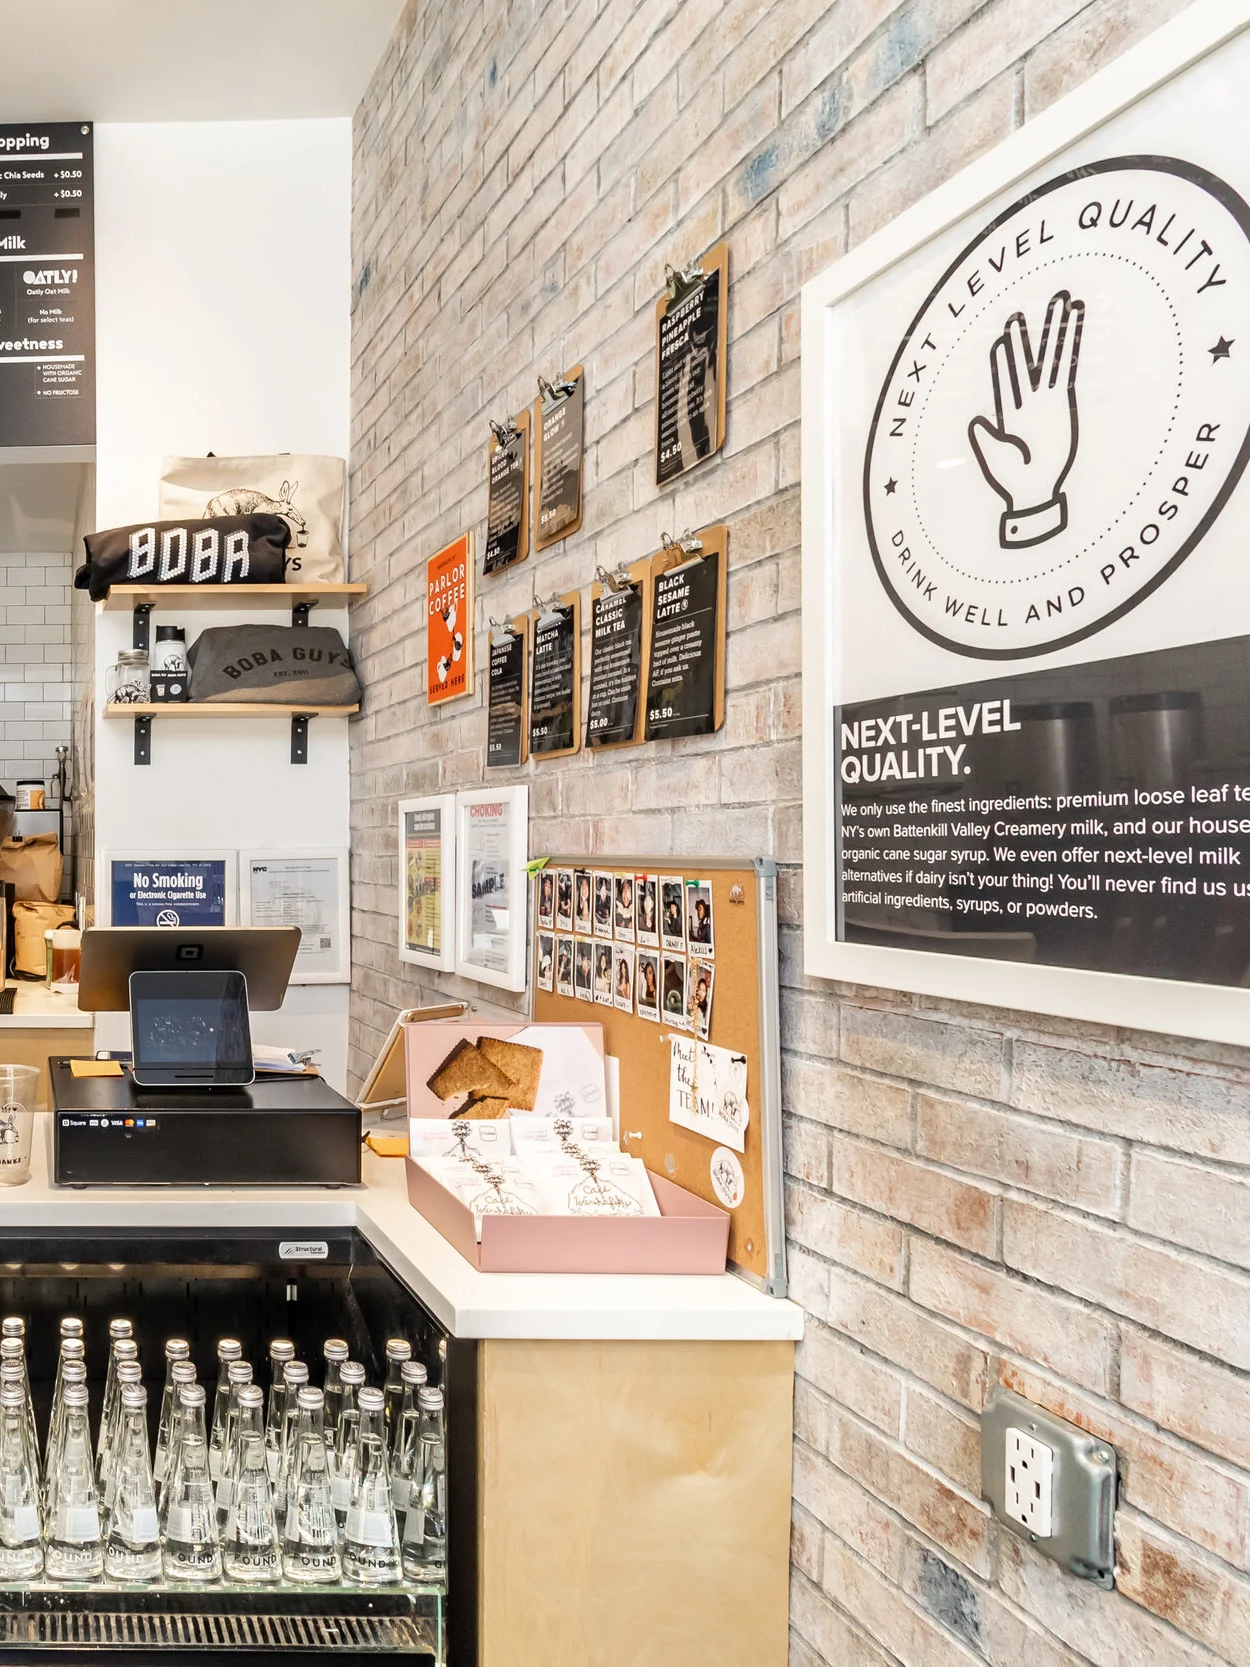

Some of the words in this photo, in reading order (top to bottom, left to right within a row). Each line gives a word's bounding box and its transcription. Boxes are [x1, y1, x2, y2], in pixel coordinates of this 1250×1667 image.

[4, 172, 21, 180] Chia
[23, 270, 78, 284] OATLY!
[662, 290, 705, 333] RASPBERRY
[889, 333, 937, 436] NEXT
[948, 220, 1054, 318] LEVEL
[1078, 200, 1226, 293] QUALITY
[662, 307, 701, 346] PINEAPPLE
[662, 333, 689, 361] FRESCA
[661, 442, 682, 463] $4.50
[892, 530, 938, 601] DRINK
[945, 596, 1008, 627] WELL
[1025, 587, 1085, 624] AND
[1100, 423, 1221, 585] PROSPER
[127, 527, 250, 583] BOBA
[429, 564, 465, 596] PARLOR
[659, 574, 684, 592] BLACK
[429, 583, 465, 615] COFFEE
[658, 586, 690, 606] SESAME
[596, 609, 623, 626] CLASSIC
[657, 604, 680, 619] LATTE
[536, 630, 558, 643] MATCHA
[595, 625, 611, 638] MILK
[613, 620, 625, 631] TEA
[536, 643, 552, 655] LATTE
[222, 649, 283, 679] BOBA
[590, 718, 608, 729] $5.00
[650, 707, 672, 721] $5.50
[841, 699, 1021, 750] NEXT-LEVEL
[841, 744, 971, 784] QUALITY.
[470, 803, 502, 817] CHOKING
[841, 804, 857, 816] We
[860, 803, 883, 818] only
[885, 802, 906, 814] use
[909, 801, 927, 814] the
[930, 799, 965, 813] finest
[968, 796, 1052, 814] ingredients:
[1056, 792, 1128, 810] premium
[1134, 789, 1185, 805] loose
[1191, 785, 1229, 802] leaf
[133, 873, 149, 888] No
[152, 872, 203, 890] Smoking
[472, 873, 504, 899] SAMPLE
[138, 891, 166, 899] Electronic
[167, 891, 194, 900] Cigarette
[196, 891, 206, 899] Use
[842, 892, 882, 905] artificial
[884, 893, 952, 910] ingredients,
[956, 899, 1003, 915] syrups,
[1007, 902, 1022, 914] or
[1026, 902, 1097, 919] powders.
[234, 1553, 277, 1567] FOUND
[293, 1553, 336, 1567] FOUND
